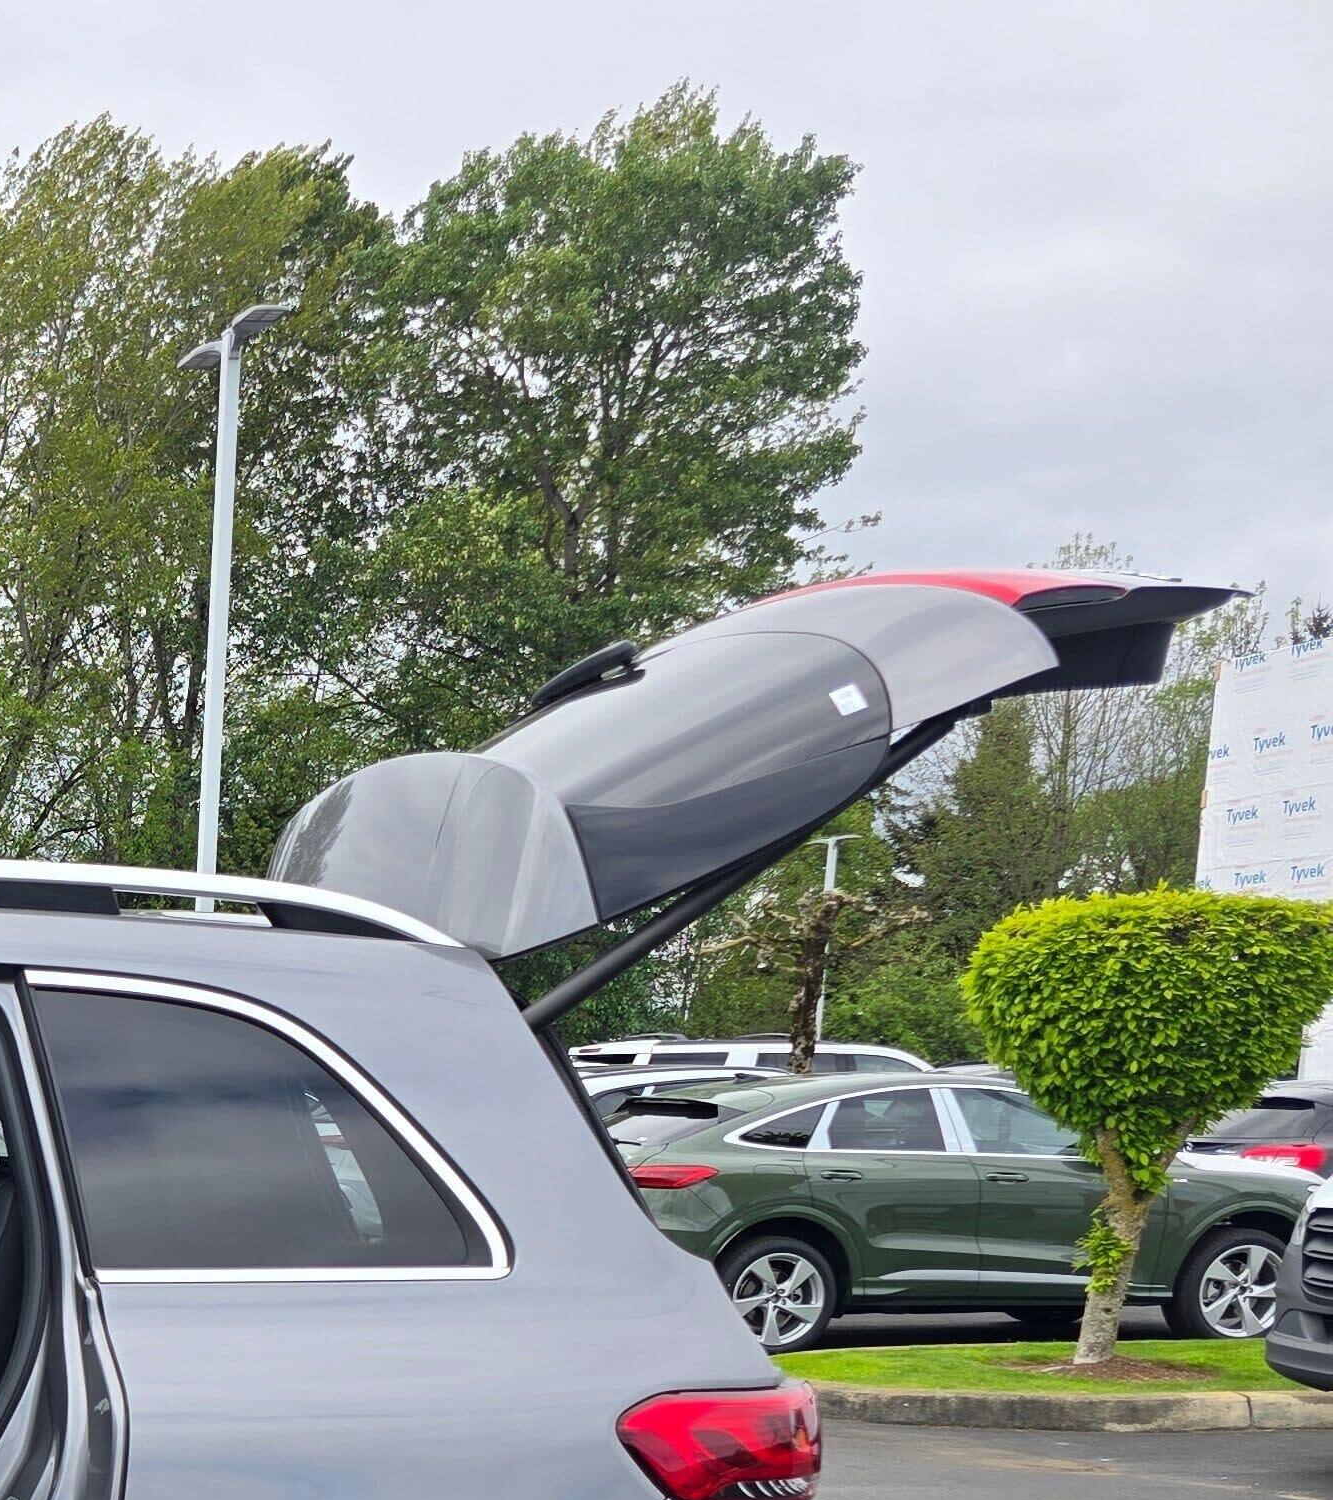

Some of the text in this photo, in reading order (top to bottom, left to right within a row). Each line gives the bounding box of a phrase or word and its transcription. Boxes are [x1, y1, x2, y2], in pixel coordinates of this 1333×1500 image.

[1253, 731, 1286, 754] Tyvek
[1311, 724, 1333, 741] Tyve
[1209, 744, 1230, 759] vek
[1226, 805, 1259, 825] Tyvek
[1282, 796, 1316, 817] Tyvek
[1234, 869, 1267, 889] Tyvek
[1290, 862, 1325, 884] Tyvek
